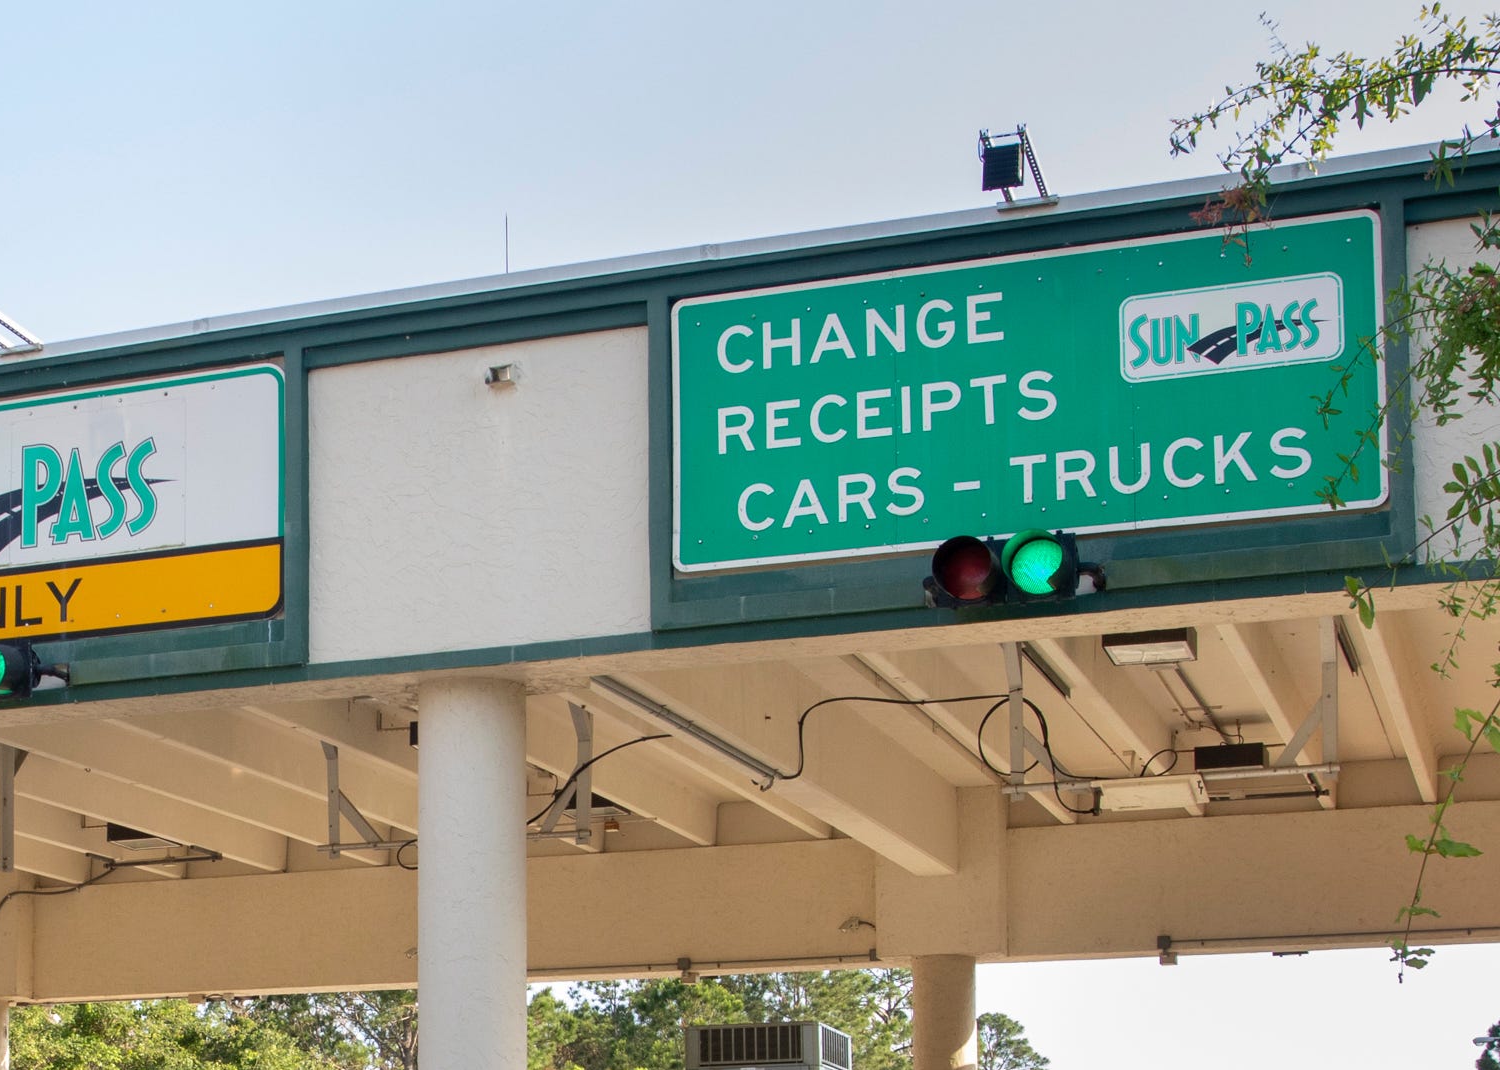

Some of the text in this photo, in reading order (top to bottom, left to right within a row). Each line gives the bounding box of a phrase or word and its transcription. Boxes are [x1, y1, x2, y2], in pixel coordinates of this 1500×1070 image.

[717, 291, 1005, 375] CHANGE
[1127, 298, 1321, 371] SUN PASS
[717, 370, 1058, 455] RECEIPTS
[20, 436, 158, 550] PASS
[738, 466, 926, 532] CARS
[1009, 427, 1313, 504] TRUCKS
